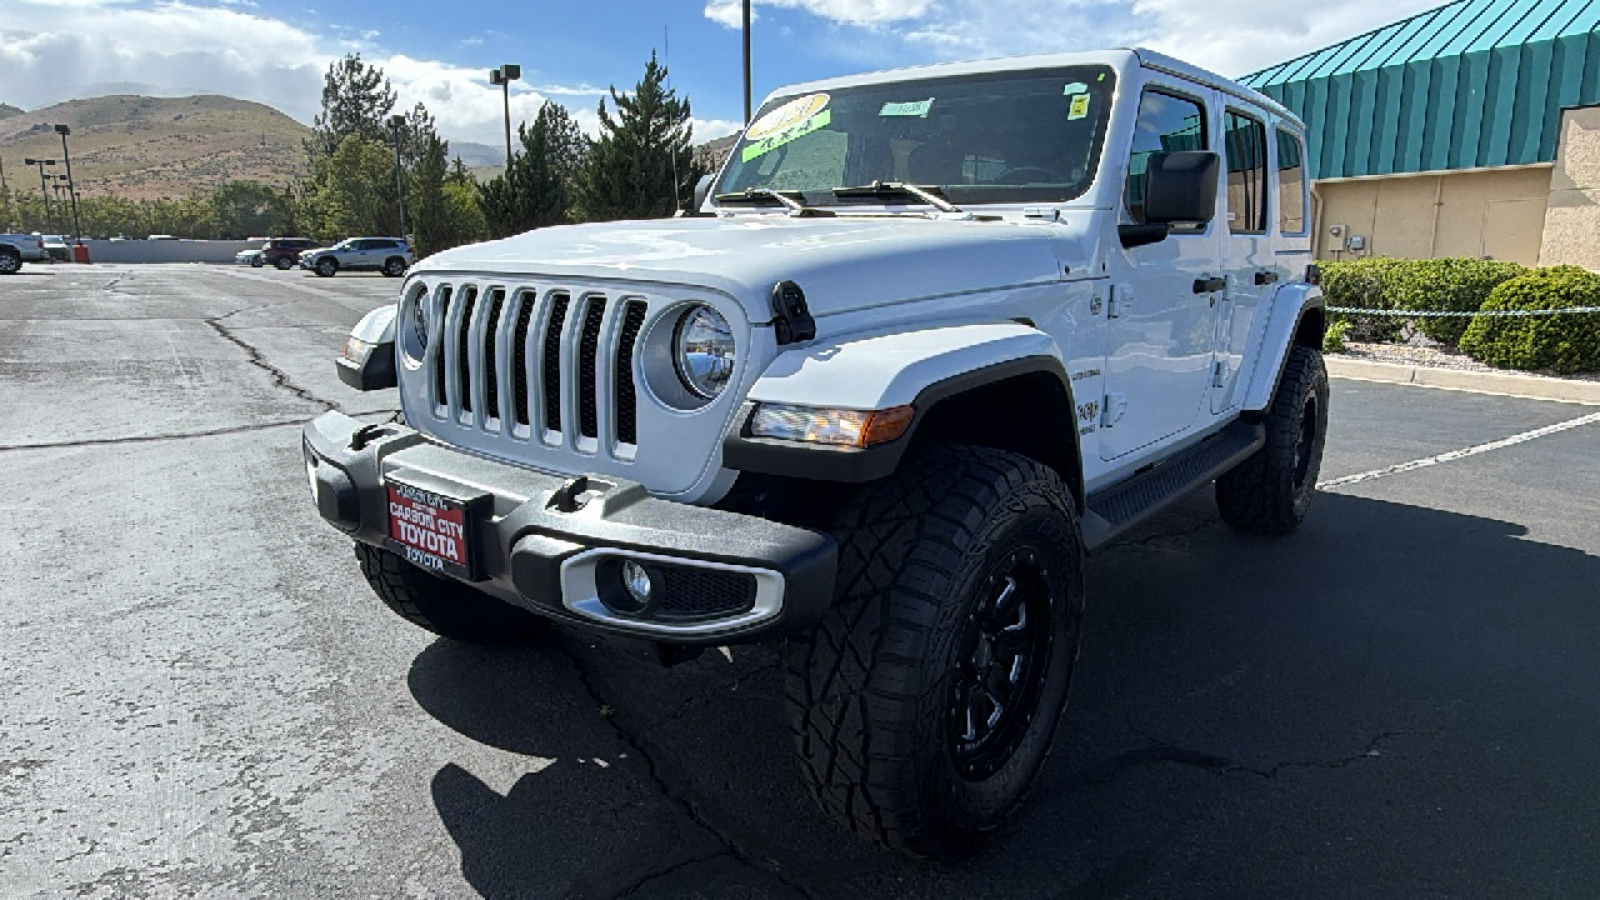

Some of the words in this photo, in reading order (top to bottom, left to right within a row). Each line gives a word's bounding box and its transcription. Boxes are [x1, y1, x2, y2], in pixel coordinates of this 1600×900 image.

[389, 502, 435, 530] CARSON
[437, 518, 463, 540] CITY
[397, 519, 458, 560] TOYOTA
[405, 545, 444, 571] TOYOTA
